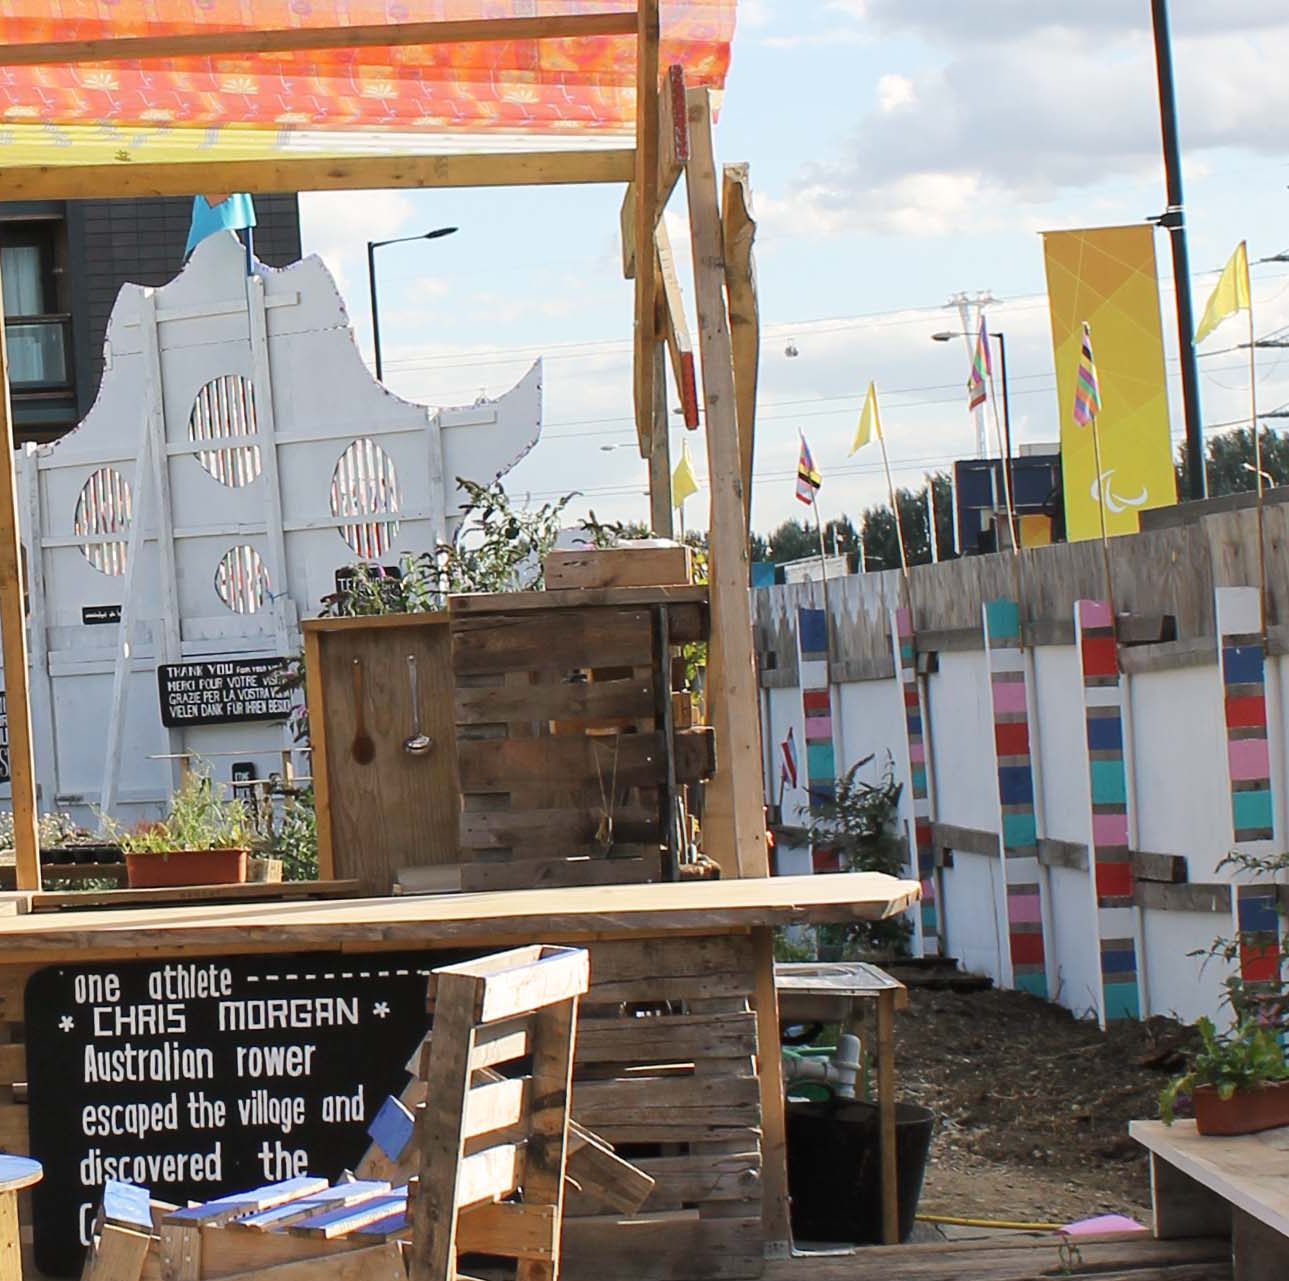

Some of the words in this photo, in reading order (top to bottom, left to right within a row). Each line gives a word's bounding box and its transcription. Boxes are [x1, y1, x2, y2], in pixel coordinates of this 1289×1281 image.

[166, 666, 203, 678] THANK
[207, 663, 234, 675] YOU
[167, 679, 196, 692] MERCI
[199, 677, 223, 690] POUR
[226, 675, 257, 688] VOTRE
[168, 691, 202, 705] GRAZIE
[203, 690, 220, 703] PER
[223, 689, 236, 702] LA
[238, 687, 270, 701] VOSTRA
[169, 704, 199, 718] VIELEN
[200, 702, 224, 717] DANK
[245, 700, 267, 714] IHREN
[74, 972, 120, 1004] one
[148, 963, 232, 1000] athlete
[93, 1004, 186, 1037] CHRIS
[218, 997, 359, 1032] MORGAN
[84, 1043, 214, 1083] Australian
[236, 1043, 317, 1077] rower
[81, 1093, 178, 1139] escaped
[187, 1094, 226, 1128] the
[238, 1090, 305, 1134] village
[321, 1084, 365, 1123] and
[79, 1142, 222, 1186] discovered
[258, 1141, 309, 1179] the
